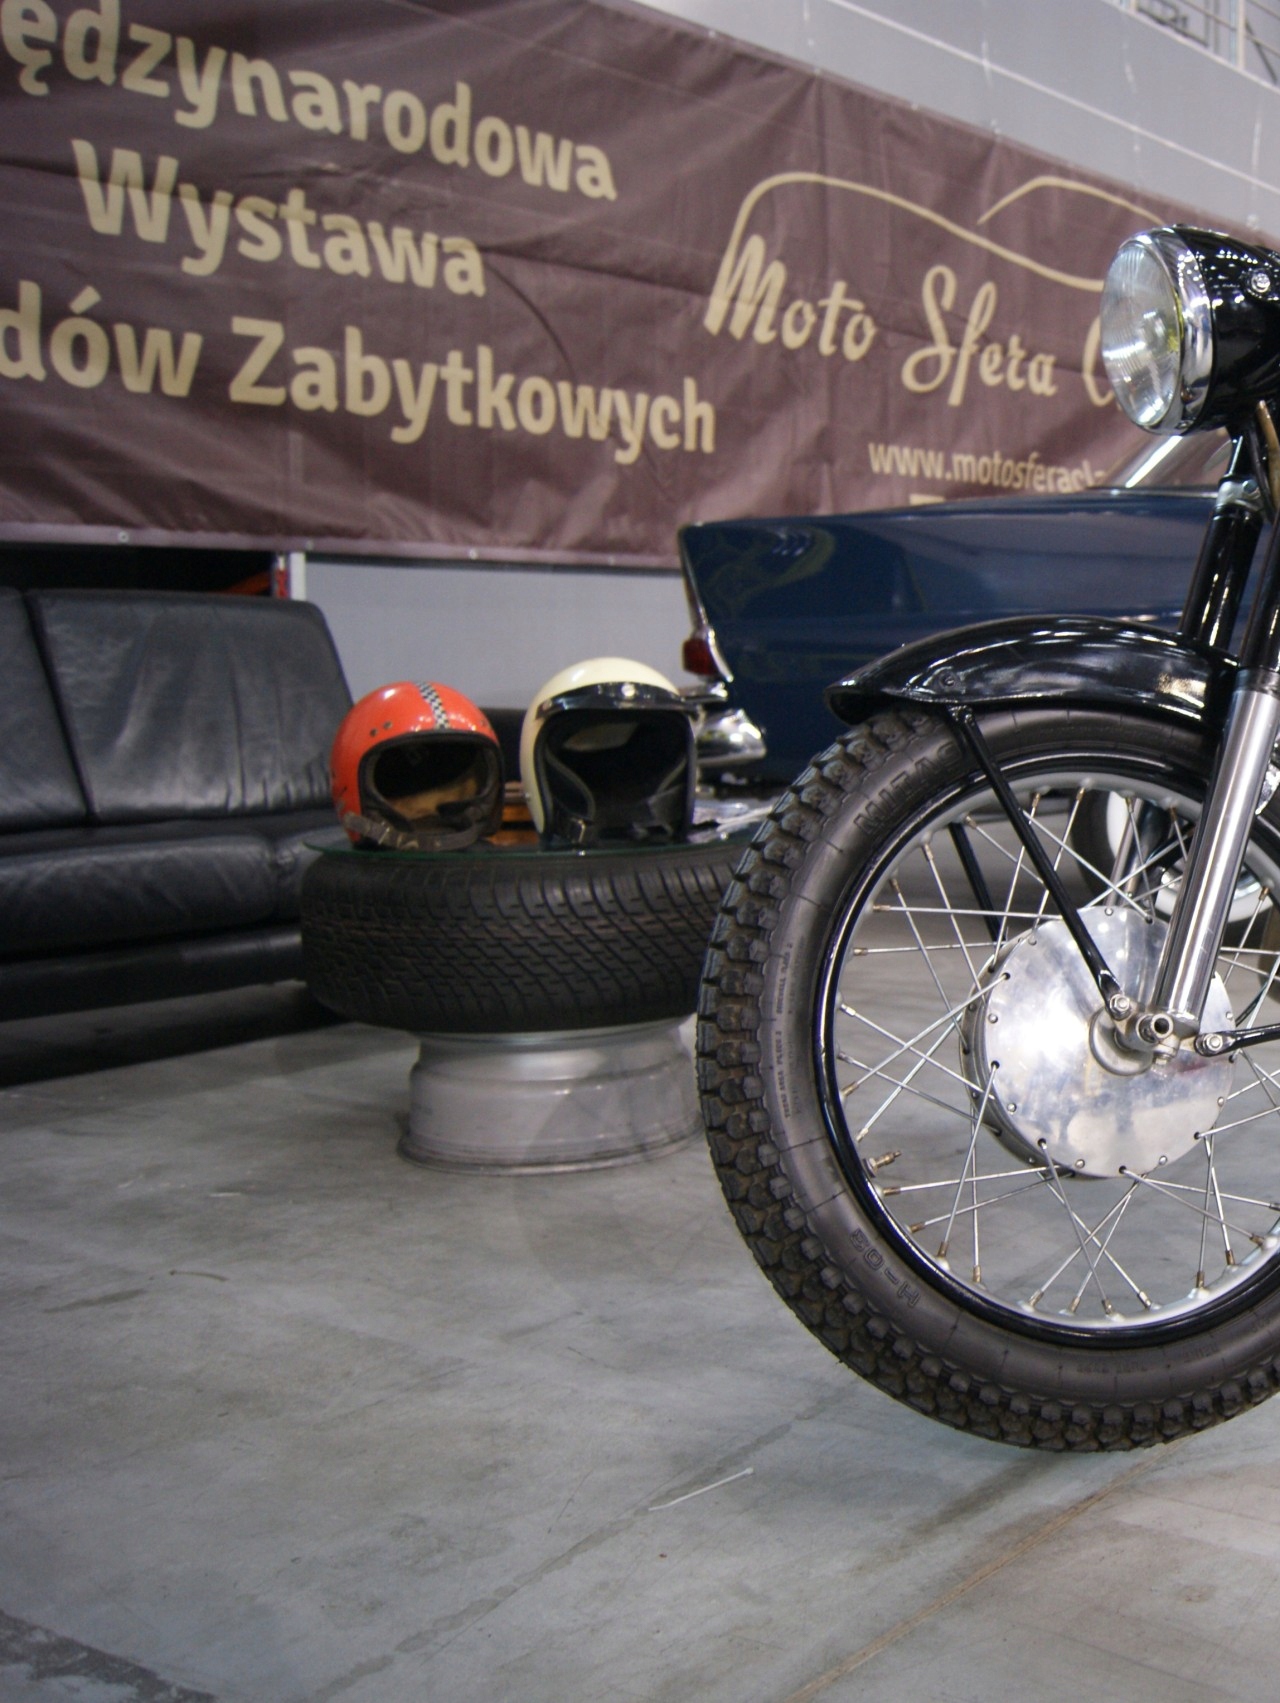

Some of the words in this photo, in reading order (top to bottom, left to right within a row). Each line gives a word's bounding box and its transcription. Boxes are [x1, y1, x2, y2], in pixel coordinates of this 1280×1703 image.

[71, 138, 487, 298] Wystawa
[229, 317, 717, 465] Zabytkowych
[704, 233, 877, 362] Moto
[902, 265, 1058, 407] Sfera
